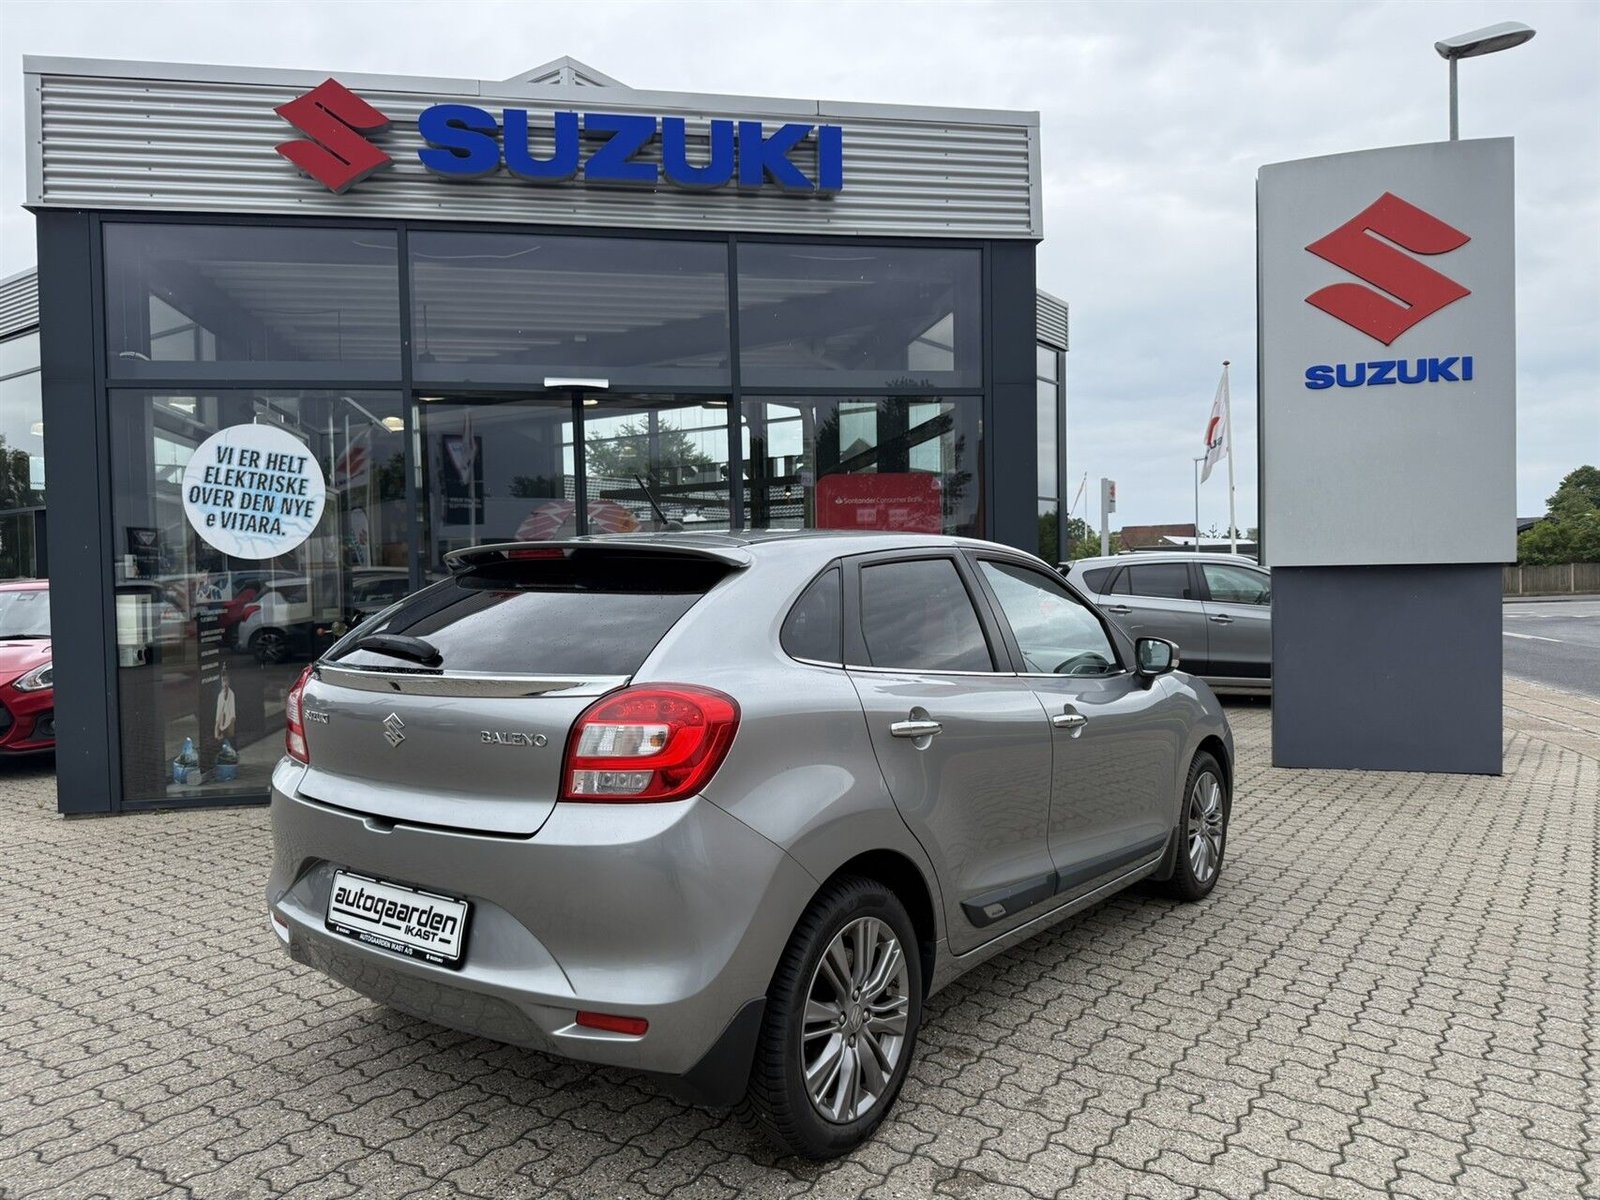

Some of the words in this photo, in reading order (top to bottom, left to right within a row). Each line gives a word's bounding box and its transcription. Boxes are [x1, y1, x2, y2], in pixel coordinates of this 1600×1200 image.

[417, 104, 843, 194] SUZUKI
[1304, 356, 1473, 390] SUZUKI
[217, 445, 234, 465] VI
[238, 449, 261, 468] ER
[265, 453, 308, 474] HELT
[203, 466, 309, 496] ELEKTRISKE
[189, 485, 235, 508] OVER
[239, 491, 277, 513] DEN
[280, 498, 315, 518] NYE
[206, 513, 216, 527] e
[221, 511, 286, 536] VITARA.
[481, 730, 548, 747] BALENO
[334, 886, 458, 936] autogaarden
[404, 925, 438, 943] IKAST
